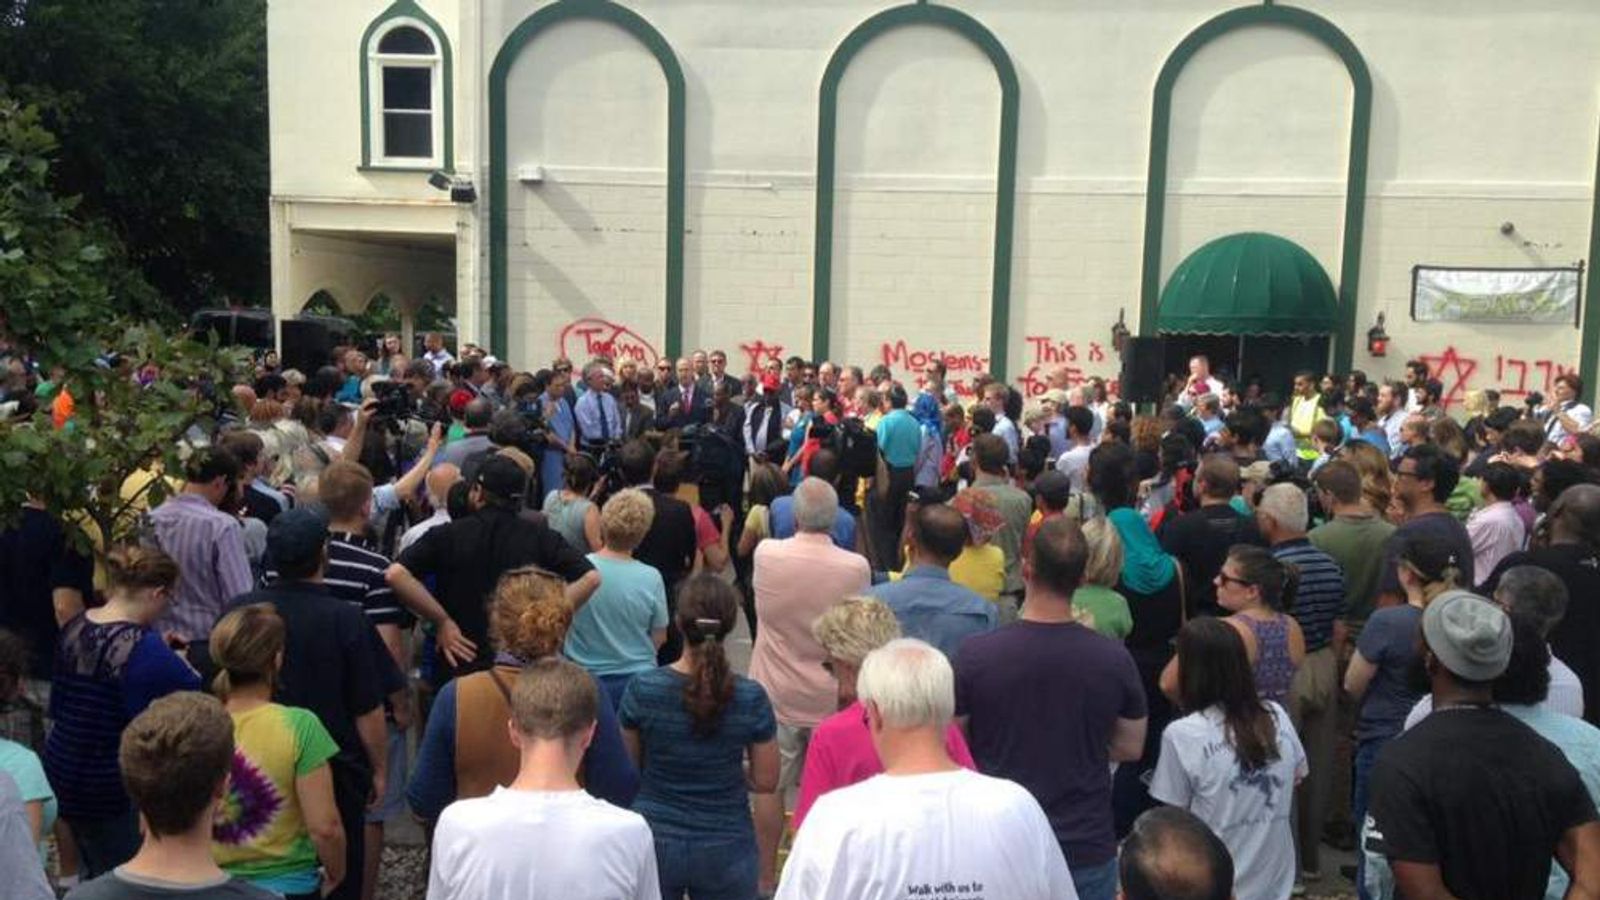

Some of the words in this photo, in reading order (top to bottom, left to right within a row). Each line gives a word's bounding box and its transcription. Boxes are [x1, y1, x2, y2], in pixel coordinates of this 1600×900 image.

[1025, 336, 1077, 364] This
[1087, 341, 1104, 361] is
[908, 883, 932, 896] Walk
[934, 881, 956, 893] with
